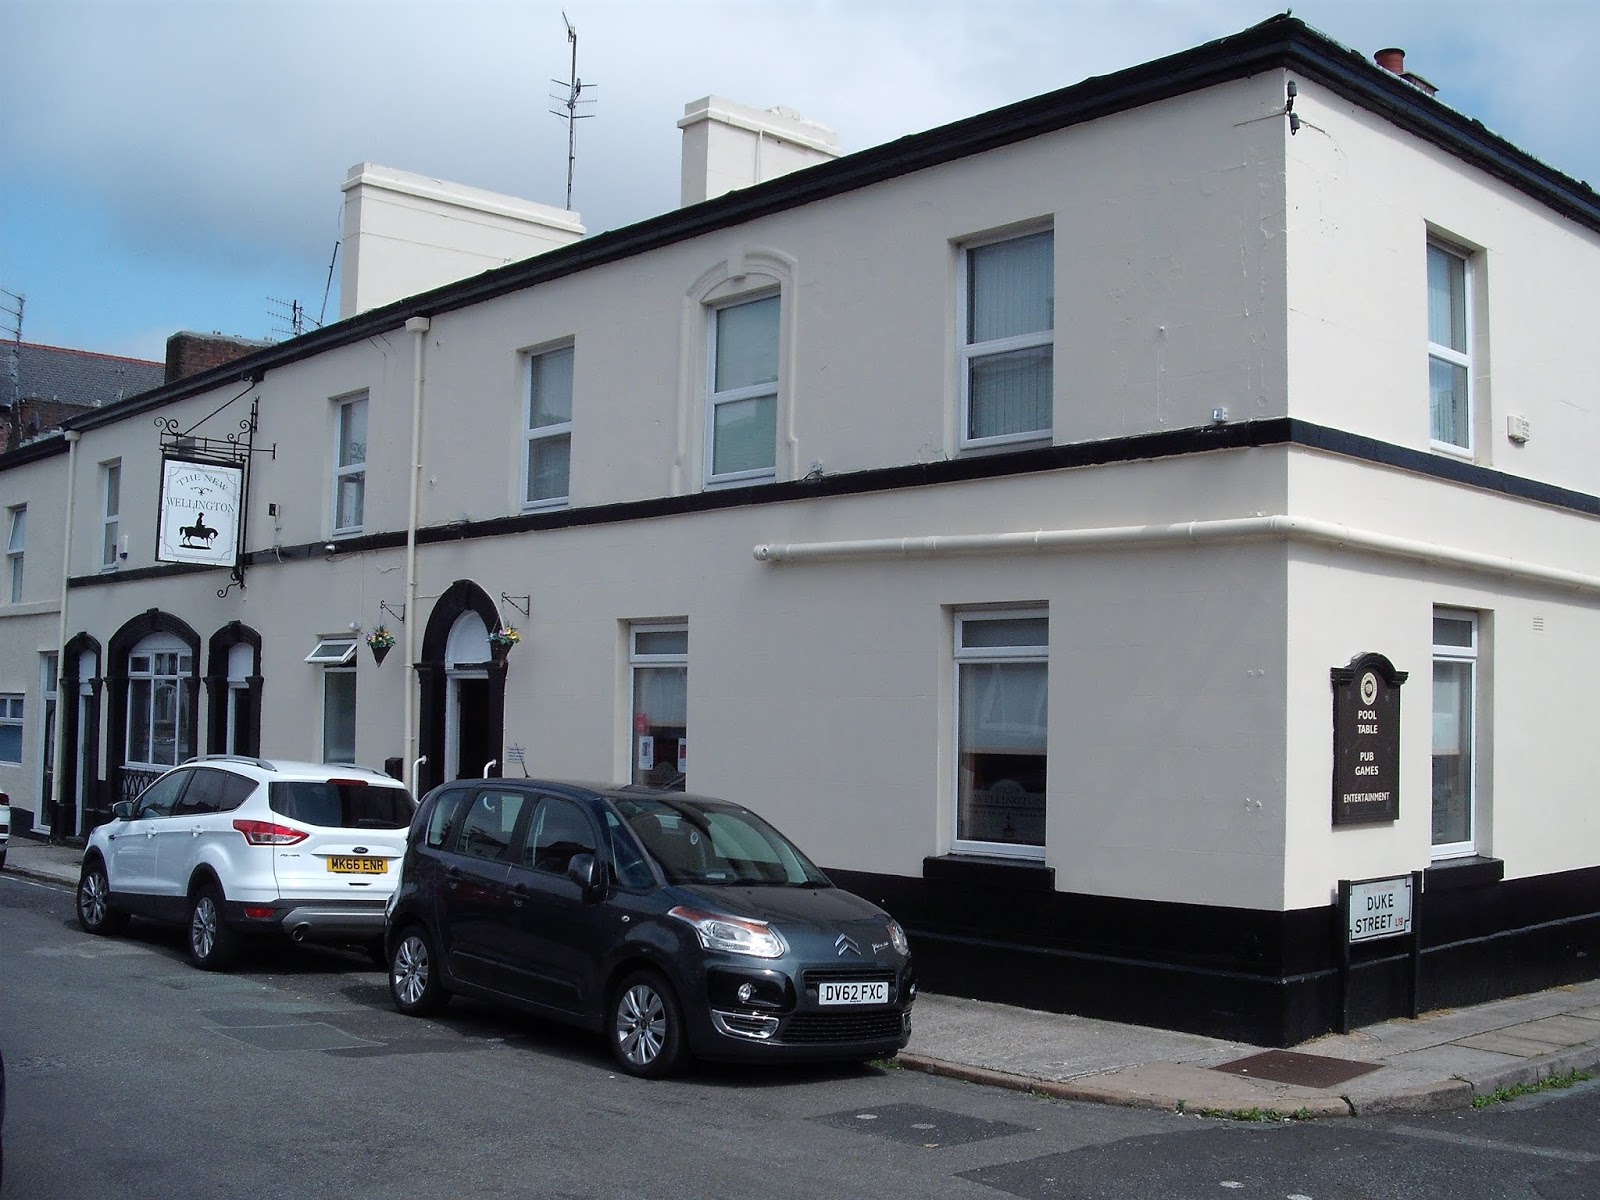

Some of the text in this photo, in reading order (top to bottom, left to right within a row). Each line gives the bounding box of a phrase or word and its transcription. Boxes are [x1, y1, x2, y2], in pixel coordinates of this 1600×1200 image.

[176, 474, 228, 491] THE NEW
[166, 496, 235, 513] WELLINGTON
[1358, 710, 1377, 720] POOL
[1357, 724, 1378, 734] TABLE
[1360, 752, 1374, 761] PUB
[1355, 766, 1379, 776] GAMES
[1343, 791, 1390, 803] ENTERTAINMENT
[331, 858, 384, 870] MK66 ENR
[1367, 893, 1394, 911] DUKE
[1355, 914, 1393, 934] STREET
[825, 984, 884, 1001] DV62 FXC
